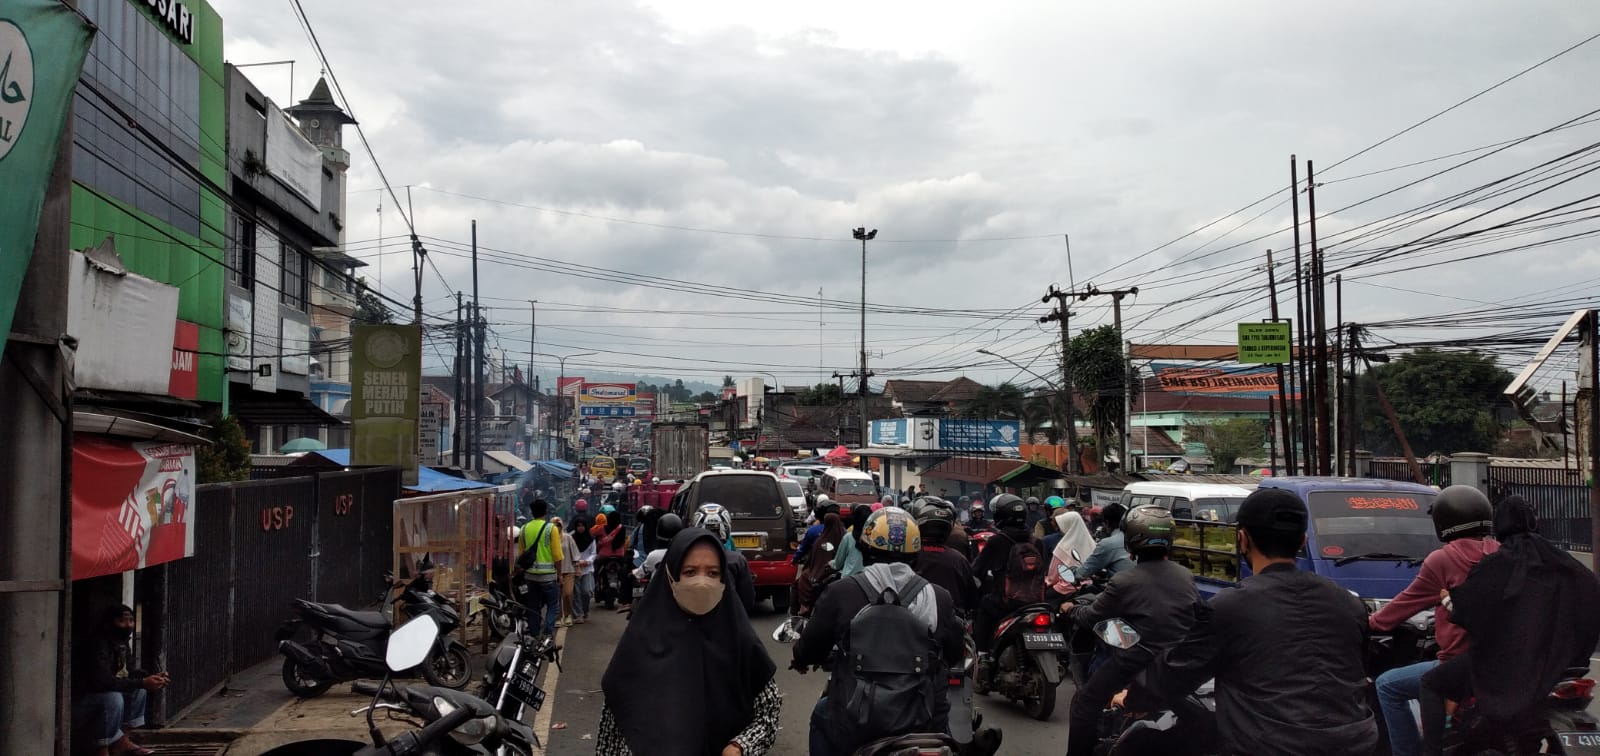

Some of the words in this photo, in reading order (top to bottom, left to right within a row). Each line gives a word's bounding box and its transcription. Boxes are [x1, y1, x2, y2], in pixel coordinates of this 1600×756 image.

[147, 0, 194, 44] SARI
[364, 371, 407, 386] SEMEN
[1161, 376, 1189, 387] SMK
[362, 385, 408, 400] MERAH
[365, 400, 405, 414] PUTIH
[336, 493, 353, 515] USP
[261, 505, 294, 531] USP
[1562, 735, 1572, 747] Z
